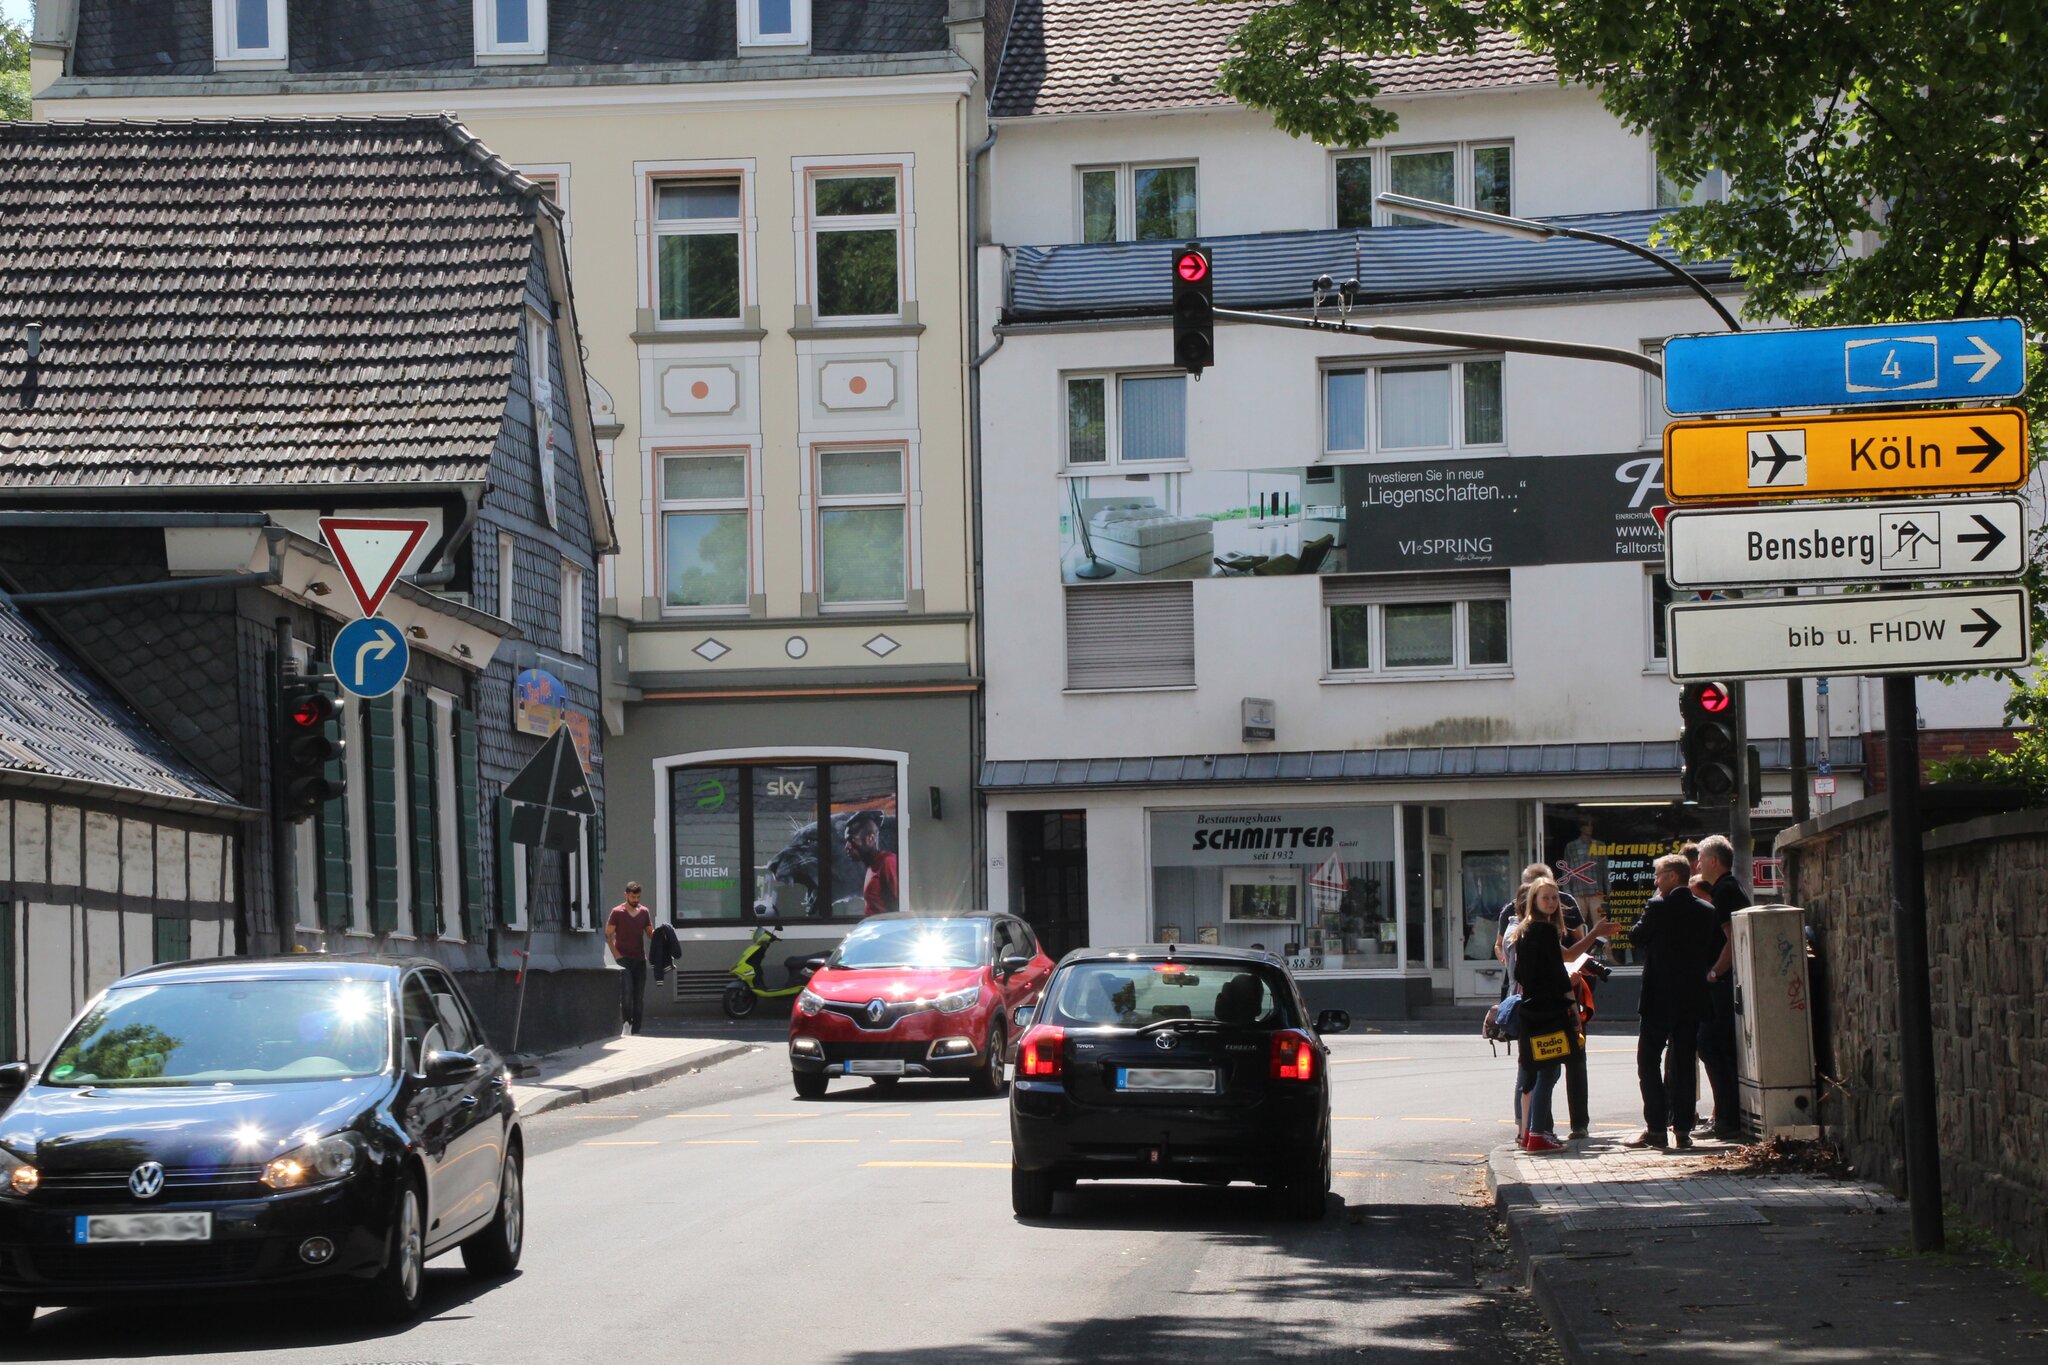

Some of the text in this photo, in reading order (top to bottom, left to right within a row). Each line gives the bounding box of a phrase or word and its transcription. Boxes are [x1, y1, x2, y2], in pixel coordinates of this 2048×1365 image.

[1881, 349, 1902, 379] 4
[1851, 436, 1942, 472] Köln
[1368, 469, 1484, 484] Investieren Sie in neue
[1748, 528, 1875, 566] Bensberg
[1789, 620, 1946, 648] bib u. FHDW
[766, 776, 804, 800] sky
[1197, 813, 1282, 826] Bestattungshaus
[1192, 826, 1335, 851] SCHMITTER
[680, 855, 716, 866] FOLGE
[1253, 850, 1294, 861] seit 1932
[1607, 860, 1644, 869] Damen
[685, 867, 729, 878] DEINEM
[1607, 871, 1657, 882] Gut, güns
[1292, 958, 1306, 968] 88
[1308, 957, 1322, 968] 59
[1536, 1037, 1563, 1048] Radio
[1541, 1046, 1563, 1056] Berg
